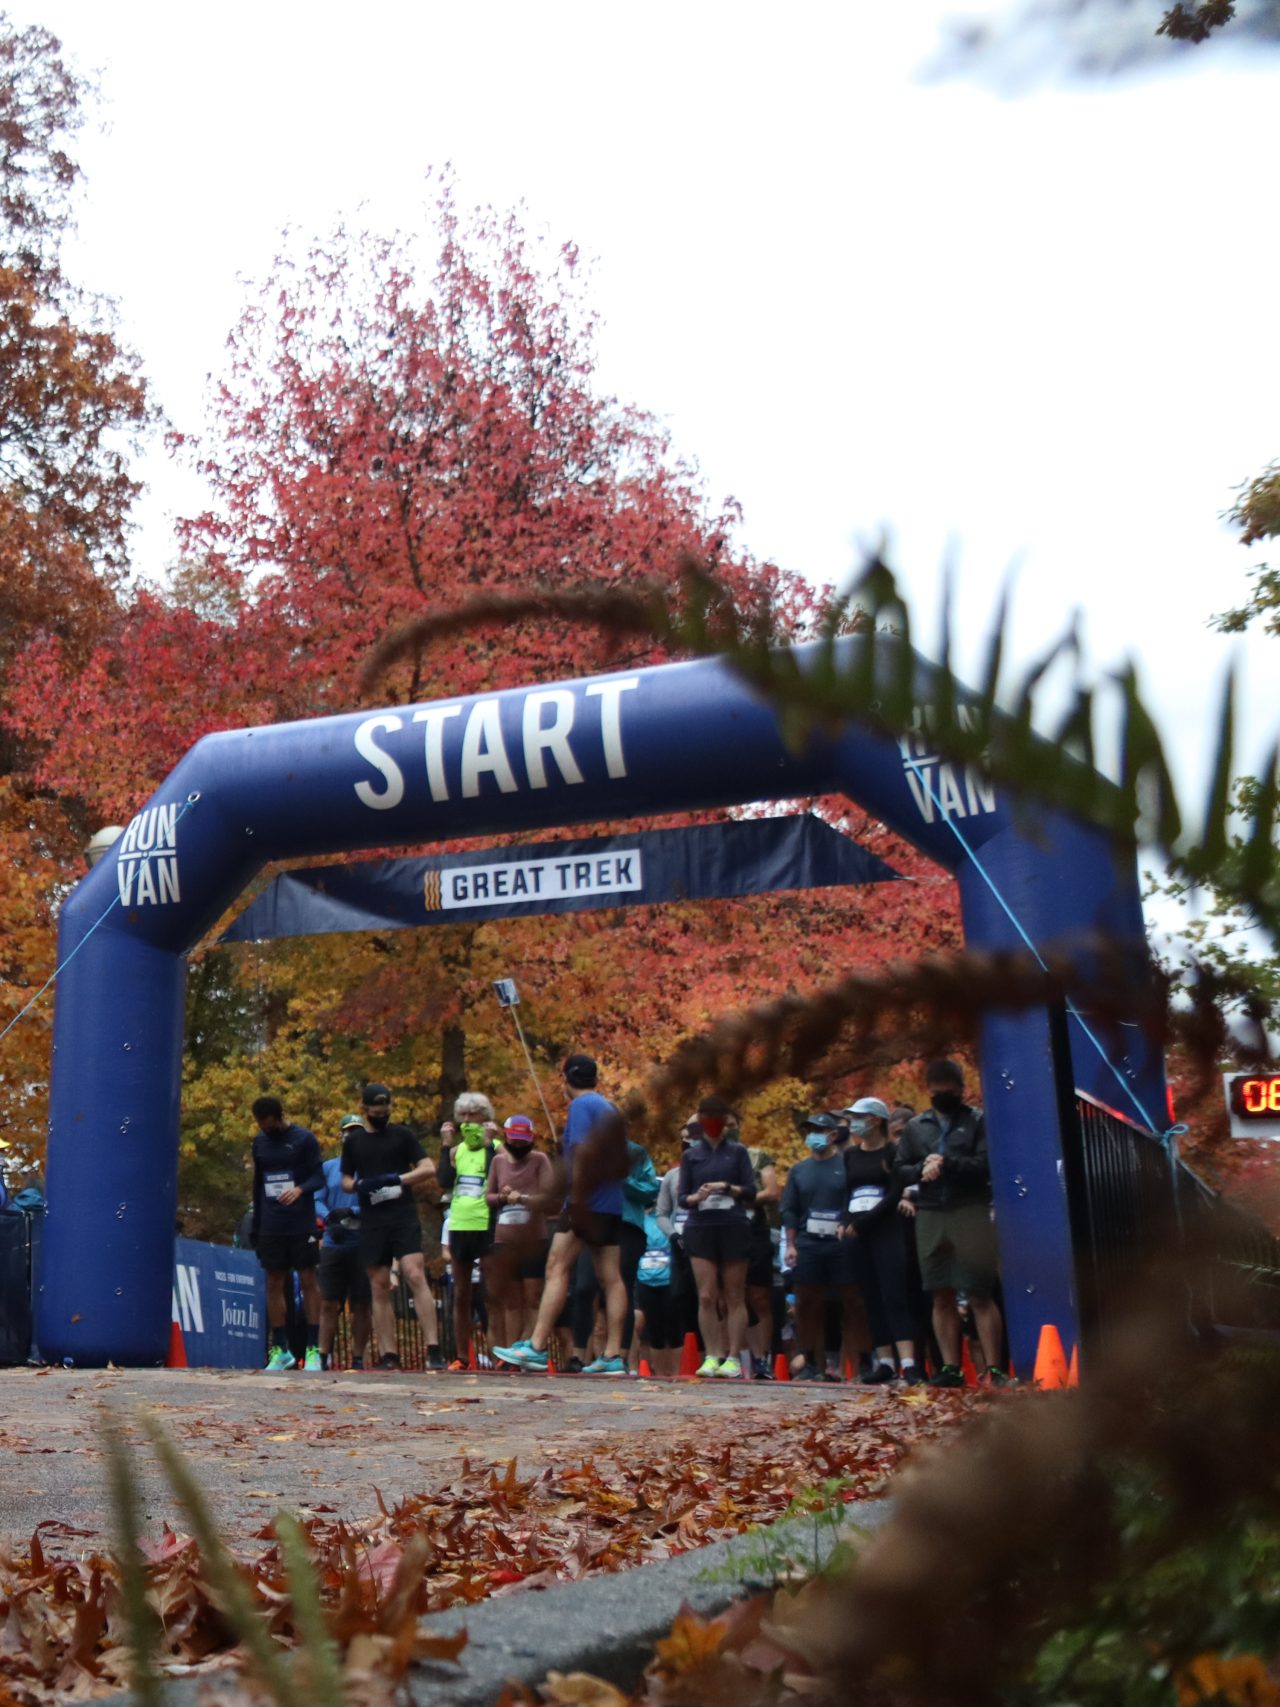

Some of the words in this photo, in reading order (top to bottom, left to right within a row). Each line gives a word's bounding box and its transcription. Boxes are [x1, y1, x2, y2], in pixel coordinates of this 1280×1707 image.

[353, 677, 639, 810] START
[904, 762, 996, 823] VAN
[120, 803, 177, 853] RUN
[117, 857, 181, 906] VAN
[452, 866, 545, 901] GREAT
[555, 857, 633, 890] TREK
[222, 1299, 246, 1327] Join
[248, 1303, 259, 1329] In
